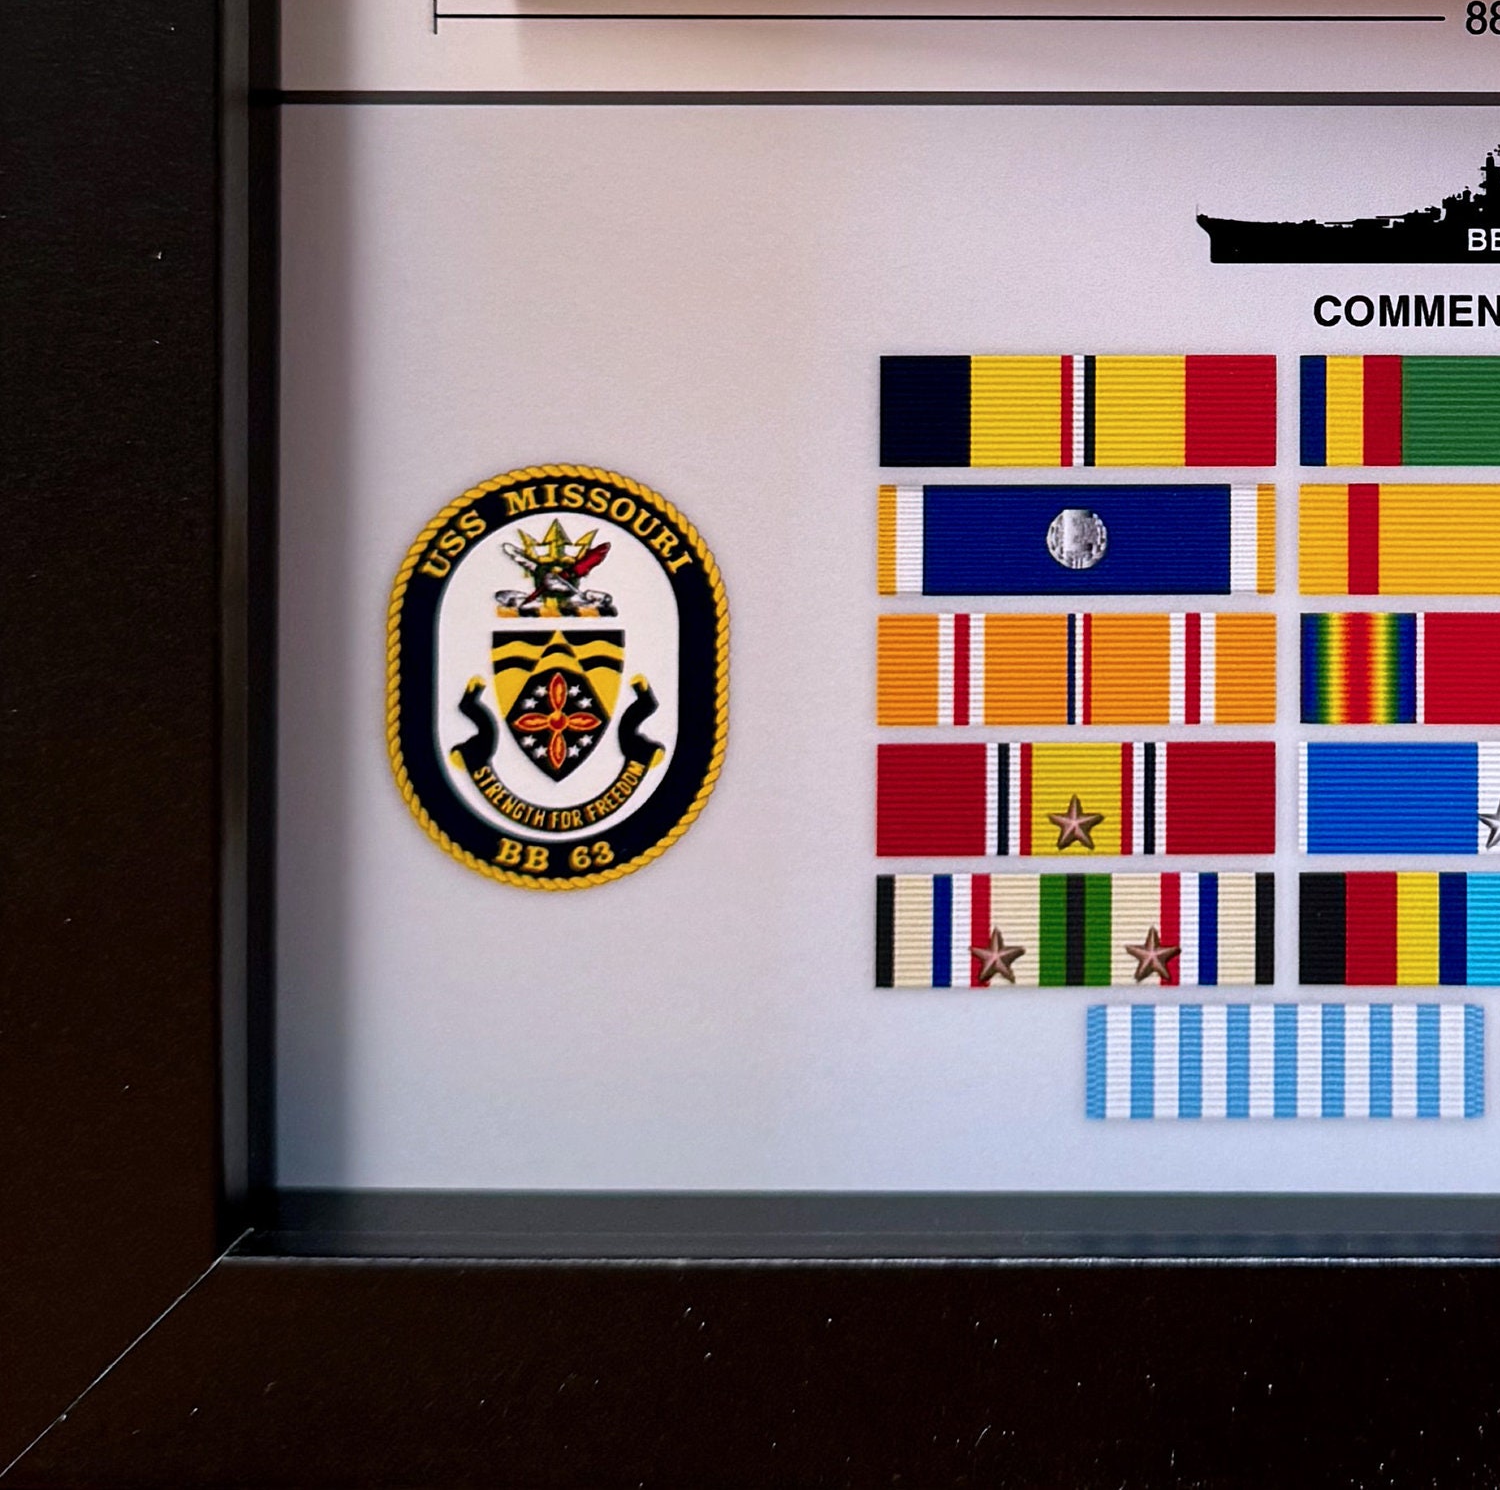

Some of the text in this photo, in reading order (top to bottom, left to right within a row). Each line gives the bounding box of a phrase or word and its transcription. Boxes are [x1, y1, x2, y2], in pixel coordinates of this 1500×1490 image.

[418, 483, 693, 579] USS MISSOURI
[473, 759, 647, 829] STRENGTH FOR FREEDOM
[494, 837, 616, 873] BB 63
